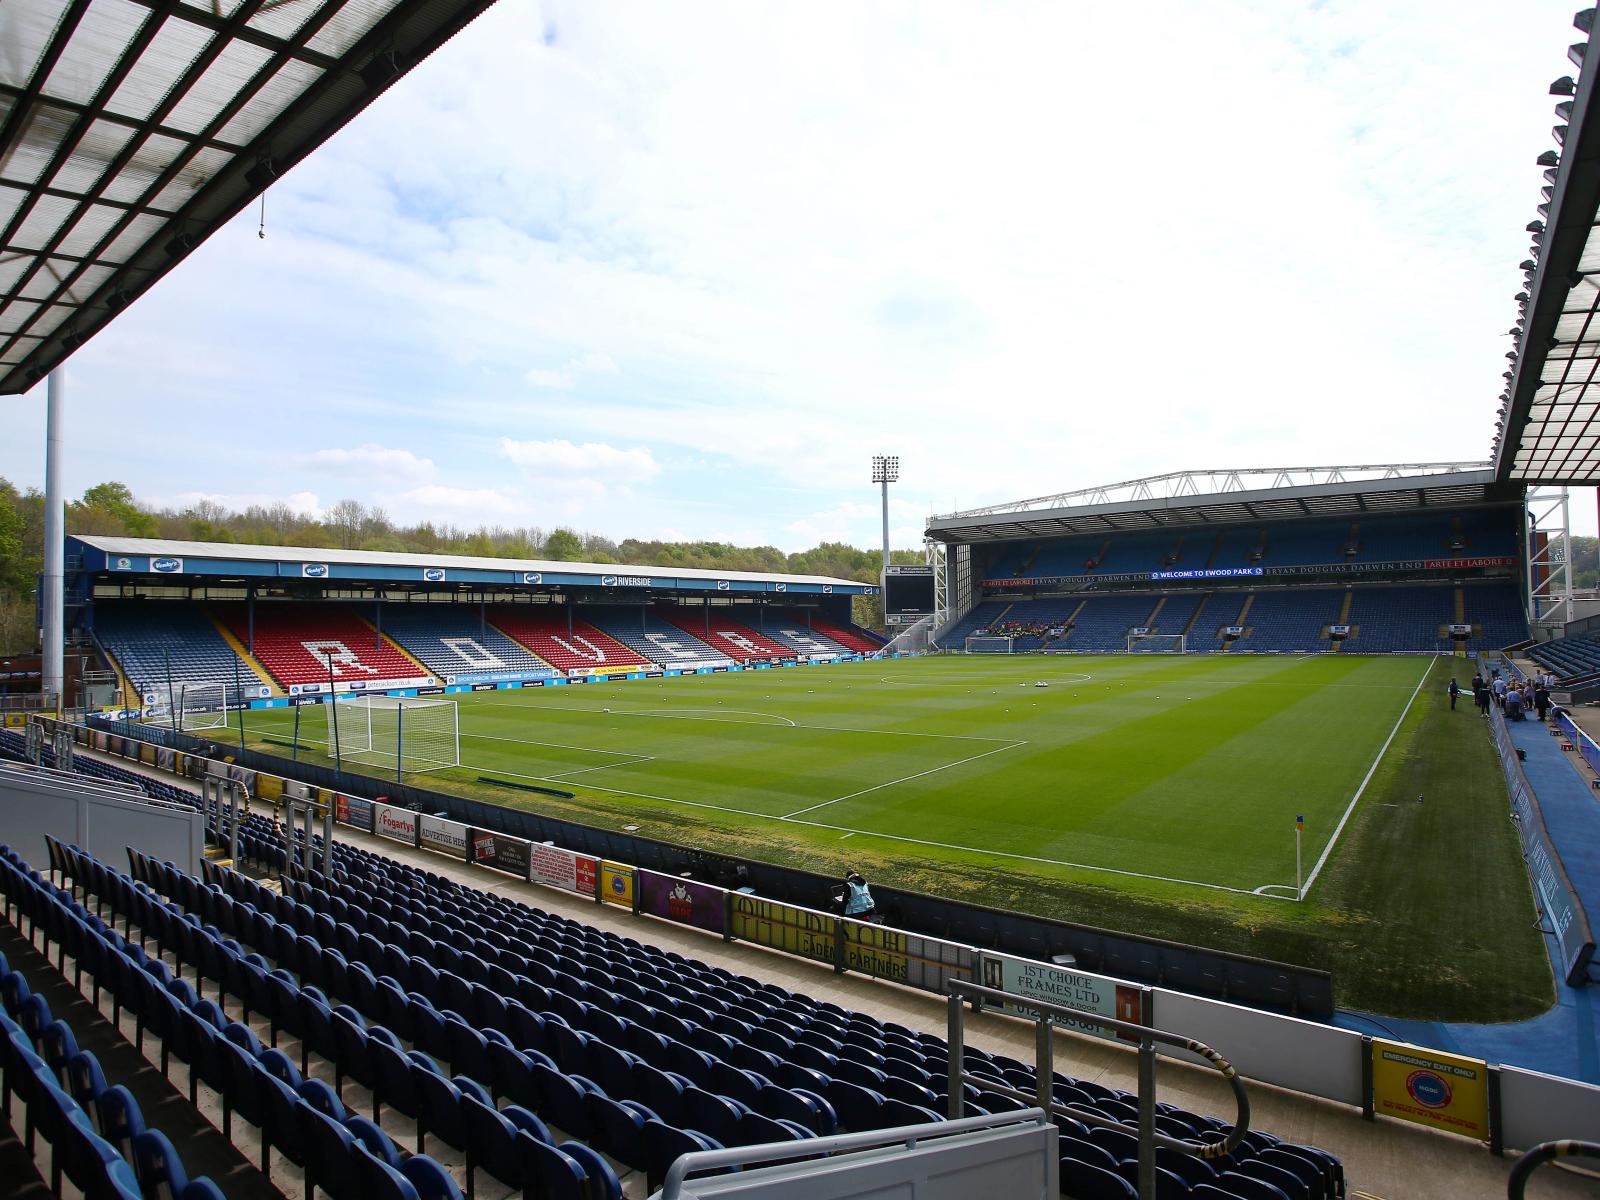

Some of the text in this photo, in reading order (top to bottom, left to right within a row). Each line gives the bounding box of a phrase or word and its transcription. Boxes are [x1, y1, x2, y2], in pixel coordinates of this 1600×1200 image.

[1300, 565, 1346, 573] DOUGLAS
[1351, 563, 1394, 571] DARWEN
[1429, 558, 1503, 568] ARTE ET LABORE
[1060, 575, 1095, 584] DOUGLAS
[1098, 574, 1130, 582] DARWEN
[1205, 569, 1232, 577] EWOOD
[617, 576, 651, 587] RIVERSIDE
[383, 814, 415, 834] Fogartys
[422, 828, 452, 845] ADVERTISE
[452, 836, 466, 848] HER
[1023, 964, 1094, 990] 1ST CHOICE
[1018, 975, 1072, 998] FRAMES
[1075, 988, 1101, 1005] LTD
[1039, 993, 1068, 1007] WINDOW
[1382, 1051, 1475, 1079] EMERGENCY EXIT ONLY
